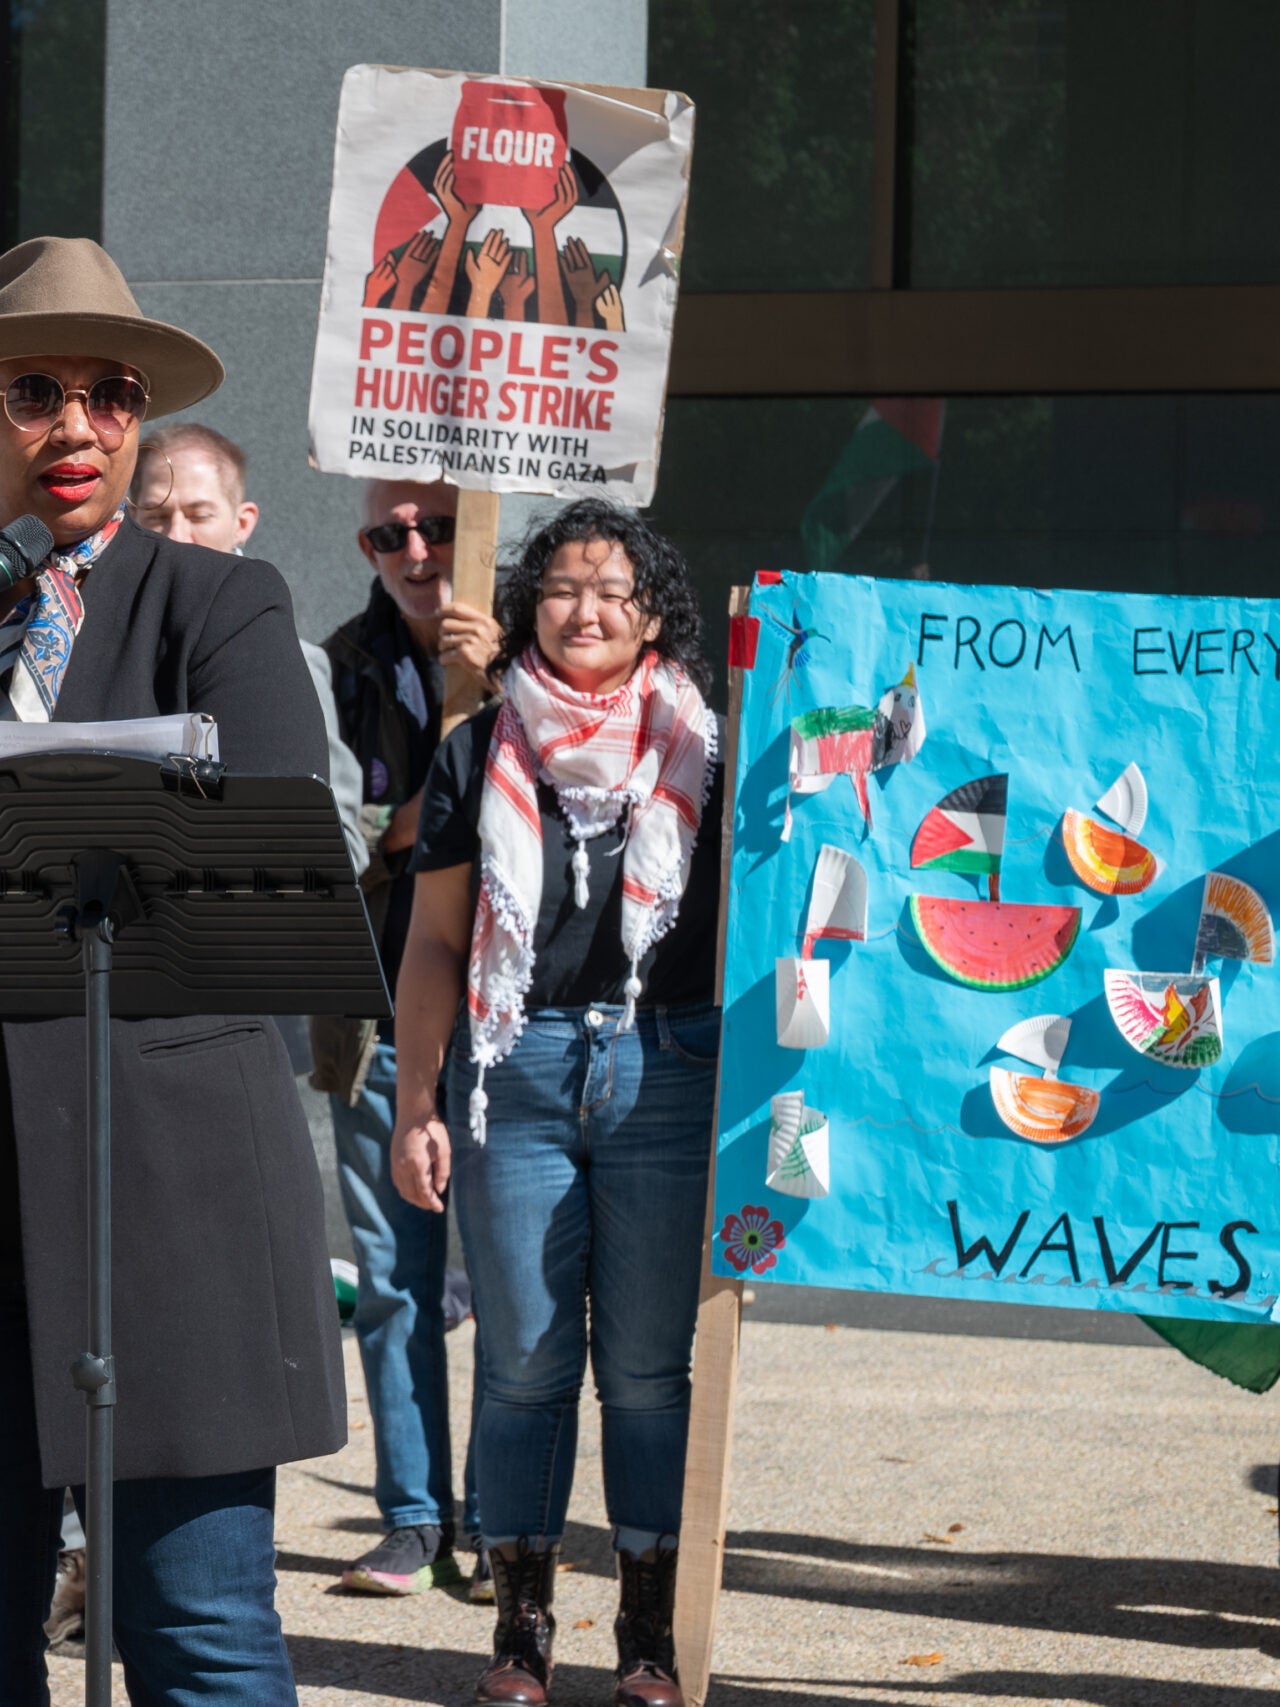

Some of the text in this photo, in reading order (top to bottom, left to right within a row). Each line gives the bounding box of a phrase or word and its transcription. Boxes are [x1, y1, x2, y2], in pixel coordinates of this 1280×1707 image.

[461, 126, 555, 168] FLOUR
[358, 318, 618, 384] PEOPLE'S
[354, 366, 614, 431] HUNGER STRIKE
[349, 441, 607, 484] PALESTINIANS IN GAZA
[352, 416, 588, 457] IN SOLIDARITY WITH
[917, 613, 1080, 671] FROM
[947, 1200, 1259, 1299] WAVES
